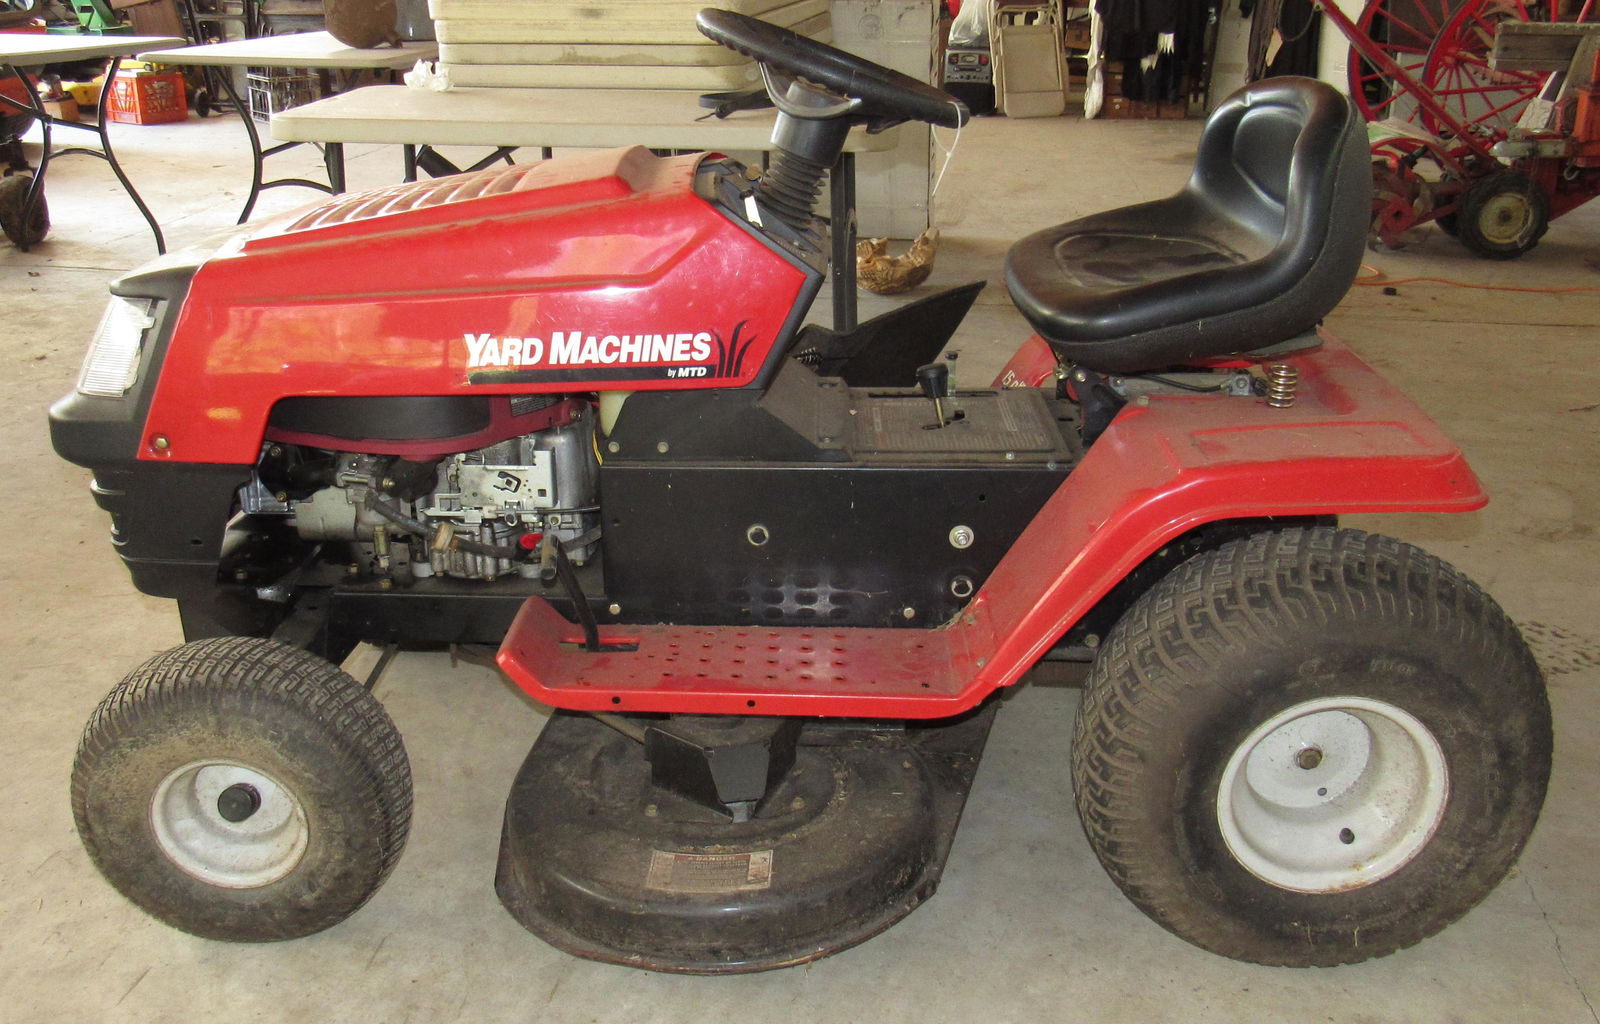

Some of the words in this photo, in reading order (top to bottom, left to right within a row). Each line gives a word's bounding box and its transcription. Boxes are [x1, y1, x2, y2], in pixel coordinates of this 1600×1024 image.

[463, 333, 543, 367] YARD
[549, 331, 711, 365] MACHINES
[667, 368, 677, 378] by
[678, 367, 707, 377] MTD
